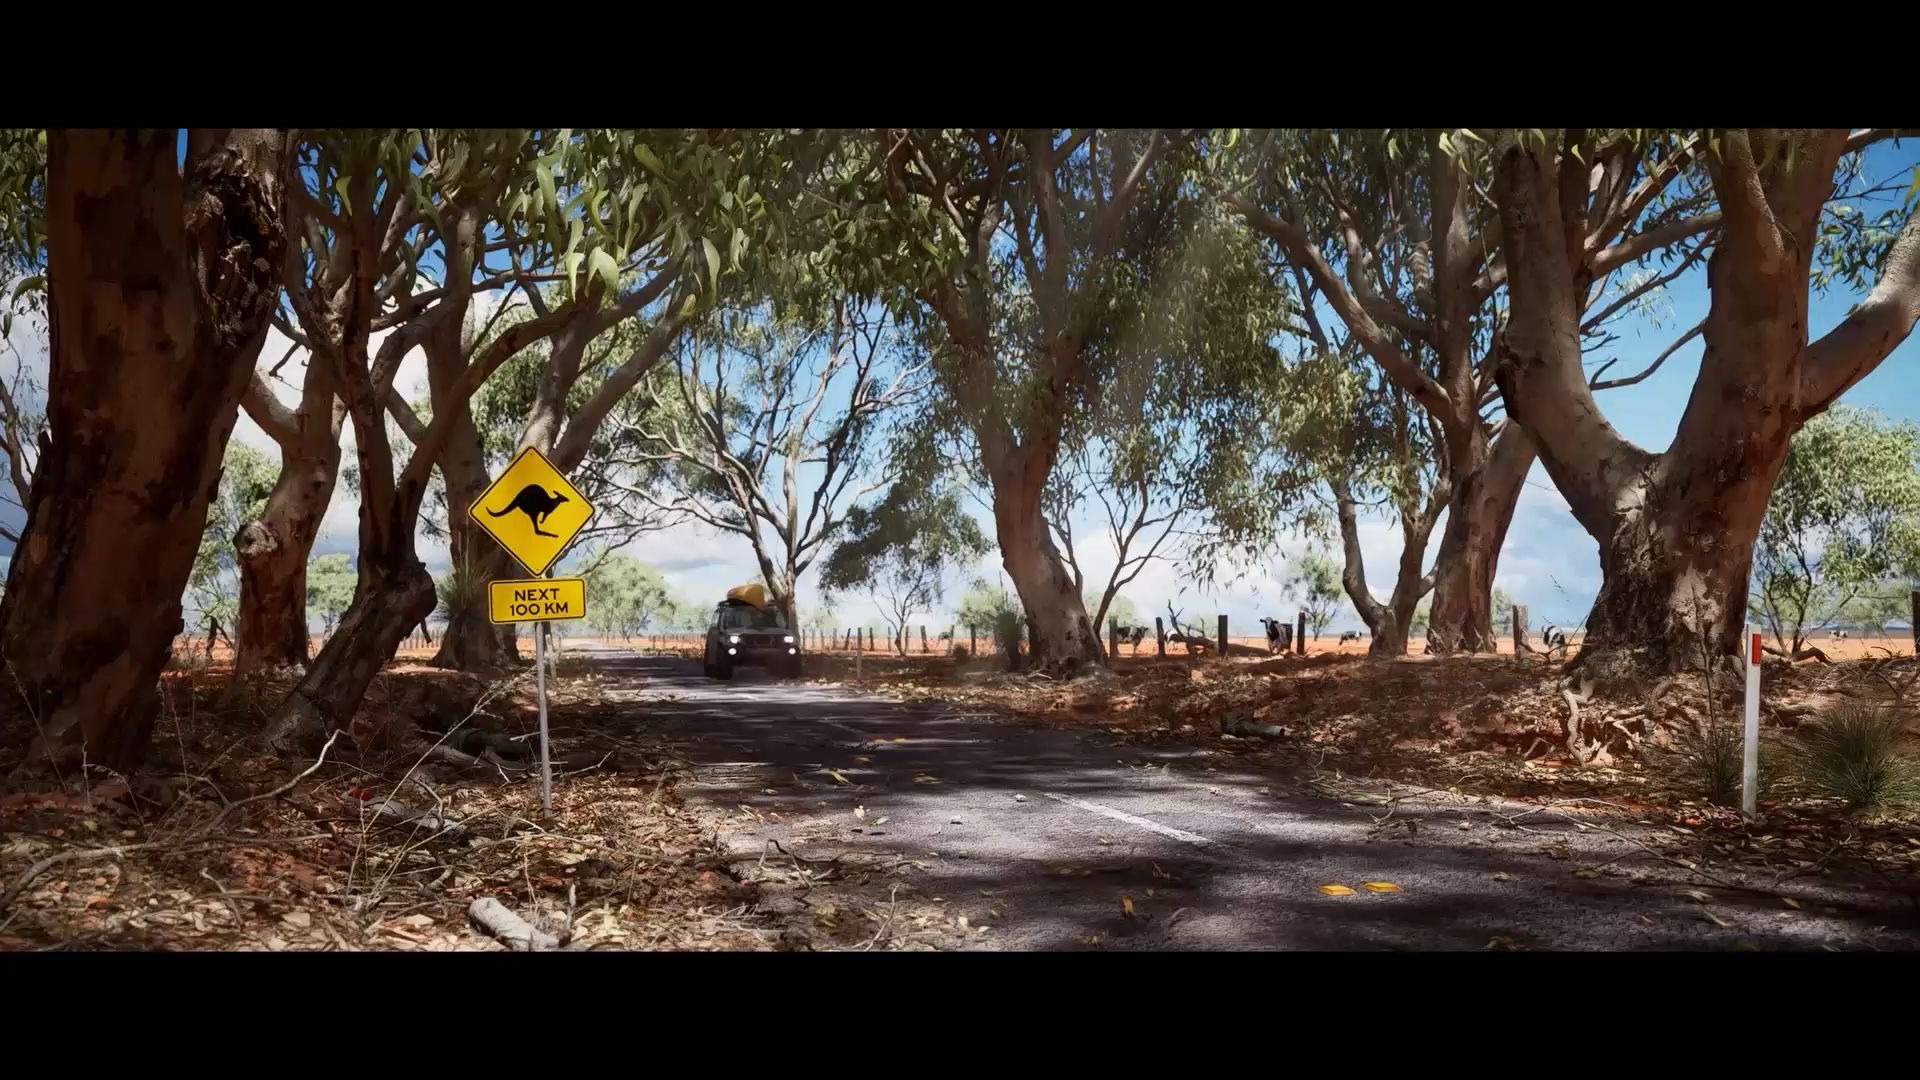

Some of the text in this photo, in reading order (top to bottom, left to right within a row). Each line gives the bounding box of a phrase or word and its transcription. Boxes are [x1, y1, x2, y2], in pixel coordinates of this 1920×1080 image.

[514, 588, 560, 602] NEXT
[510, 602, 568, 616] 100 KM
